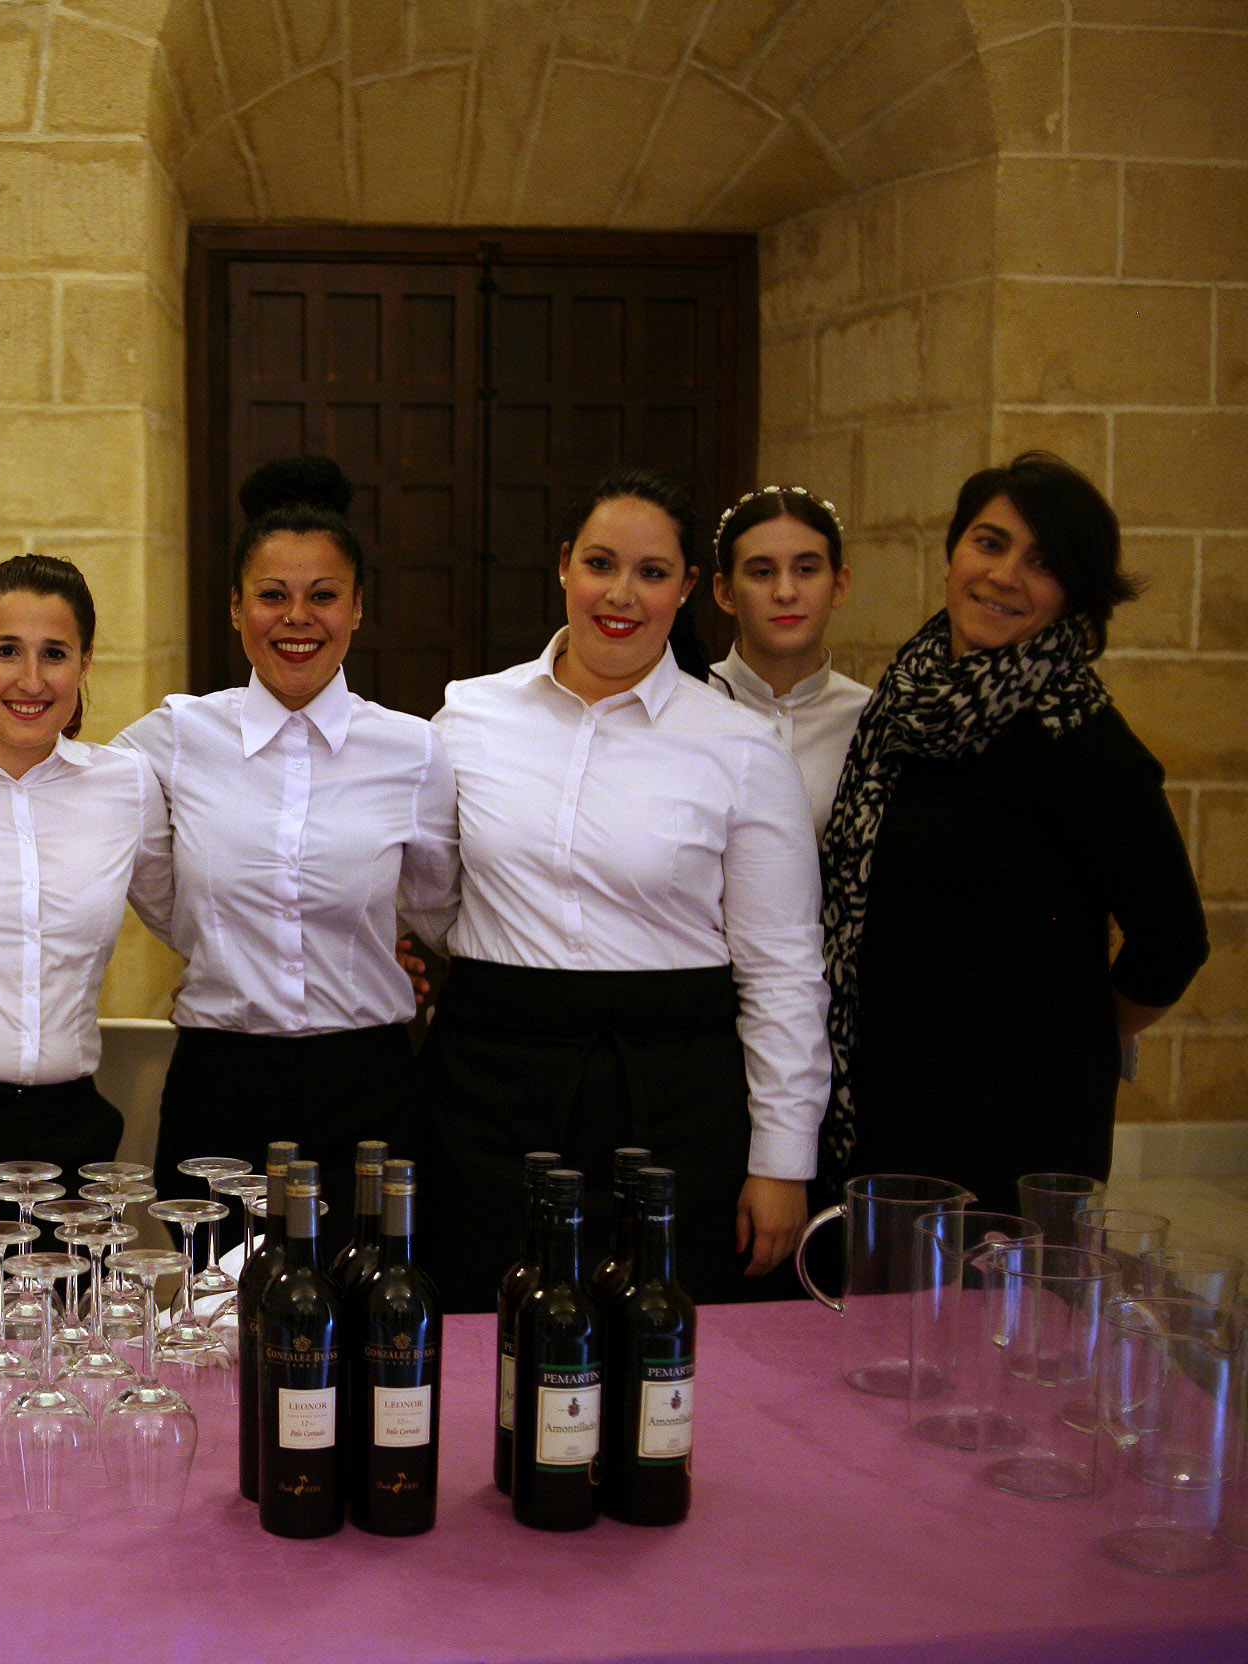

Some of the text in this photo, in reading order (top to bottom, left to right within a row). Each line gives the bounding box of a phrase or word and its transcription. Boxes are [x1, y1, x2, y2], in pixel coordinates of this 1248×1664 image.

[543, 1370, 600, 1384] PEMARTIN
[648, 1365, 693, 1378] PEMARTI
[289, 1402, 327, 1410] LEONOR
[383, 1400, 423, 1409] LEONOR
[544, 1421, 598, 1434] Amontillado
